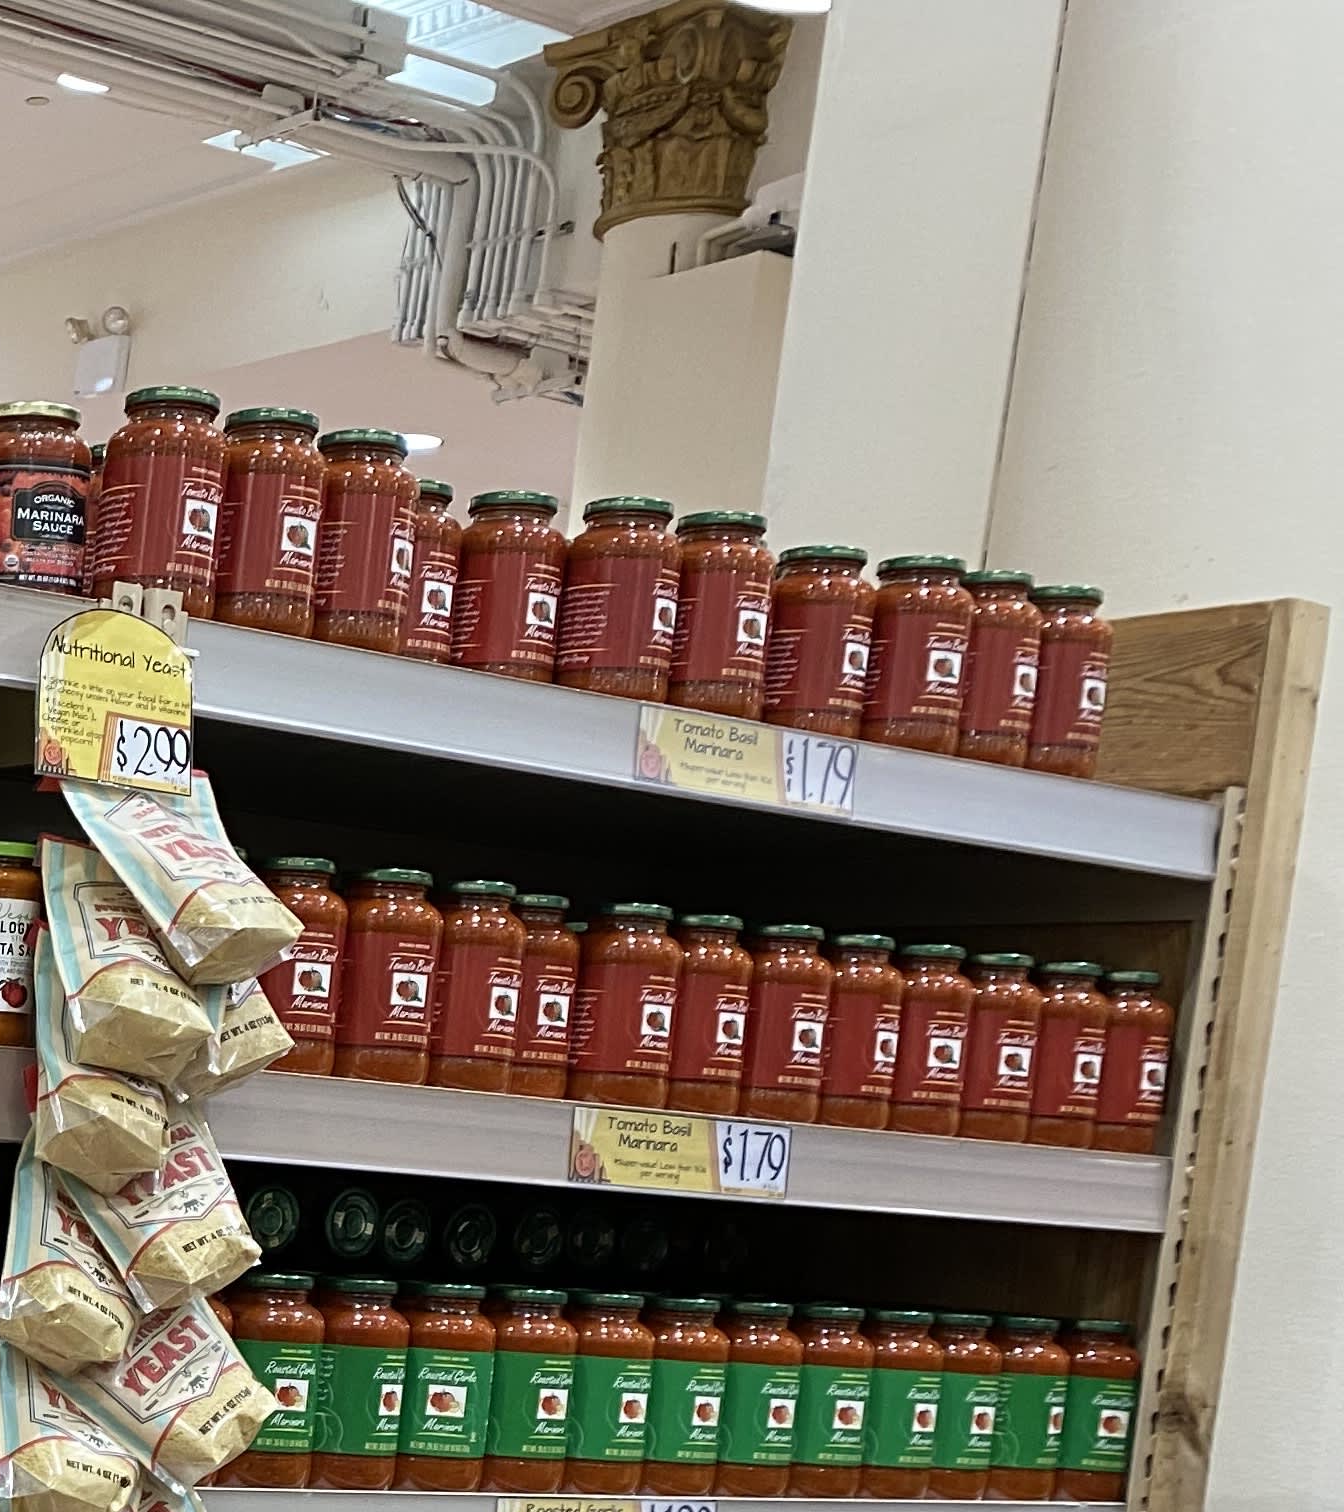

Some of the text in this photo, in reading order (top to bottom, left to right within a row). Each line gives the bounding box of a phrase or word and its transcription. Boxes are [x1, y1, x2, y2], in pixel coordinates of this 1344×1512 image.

[51, 635, 186, 678] Nutritional Yeast
[117, 719, 190, 775] $2.99
[674, 718, 758, 746] Tomato Basil
[684, 737, 744, 761] Marinara
[786, 738, 854, 805] $1.79
[608, 1116, 692, 1137] Tomato Basil
[619, 1134, 678, 1152] Marinara
[723, 1125, 786, 1181] $1.79
[122, 1314, 211, 1397] YEAST
